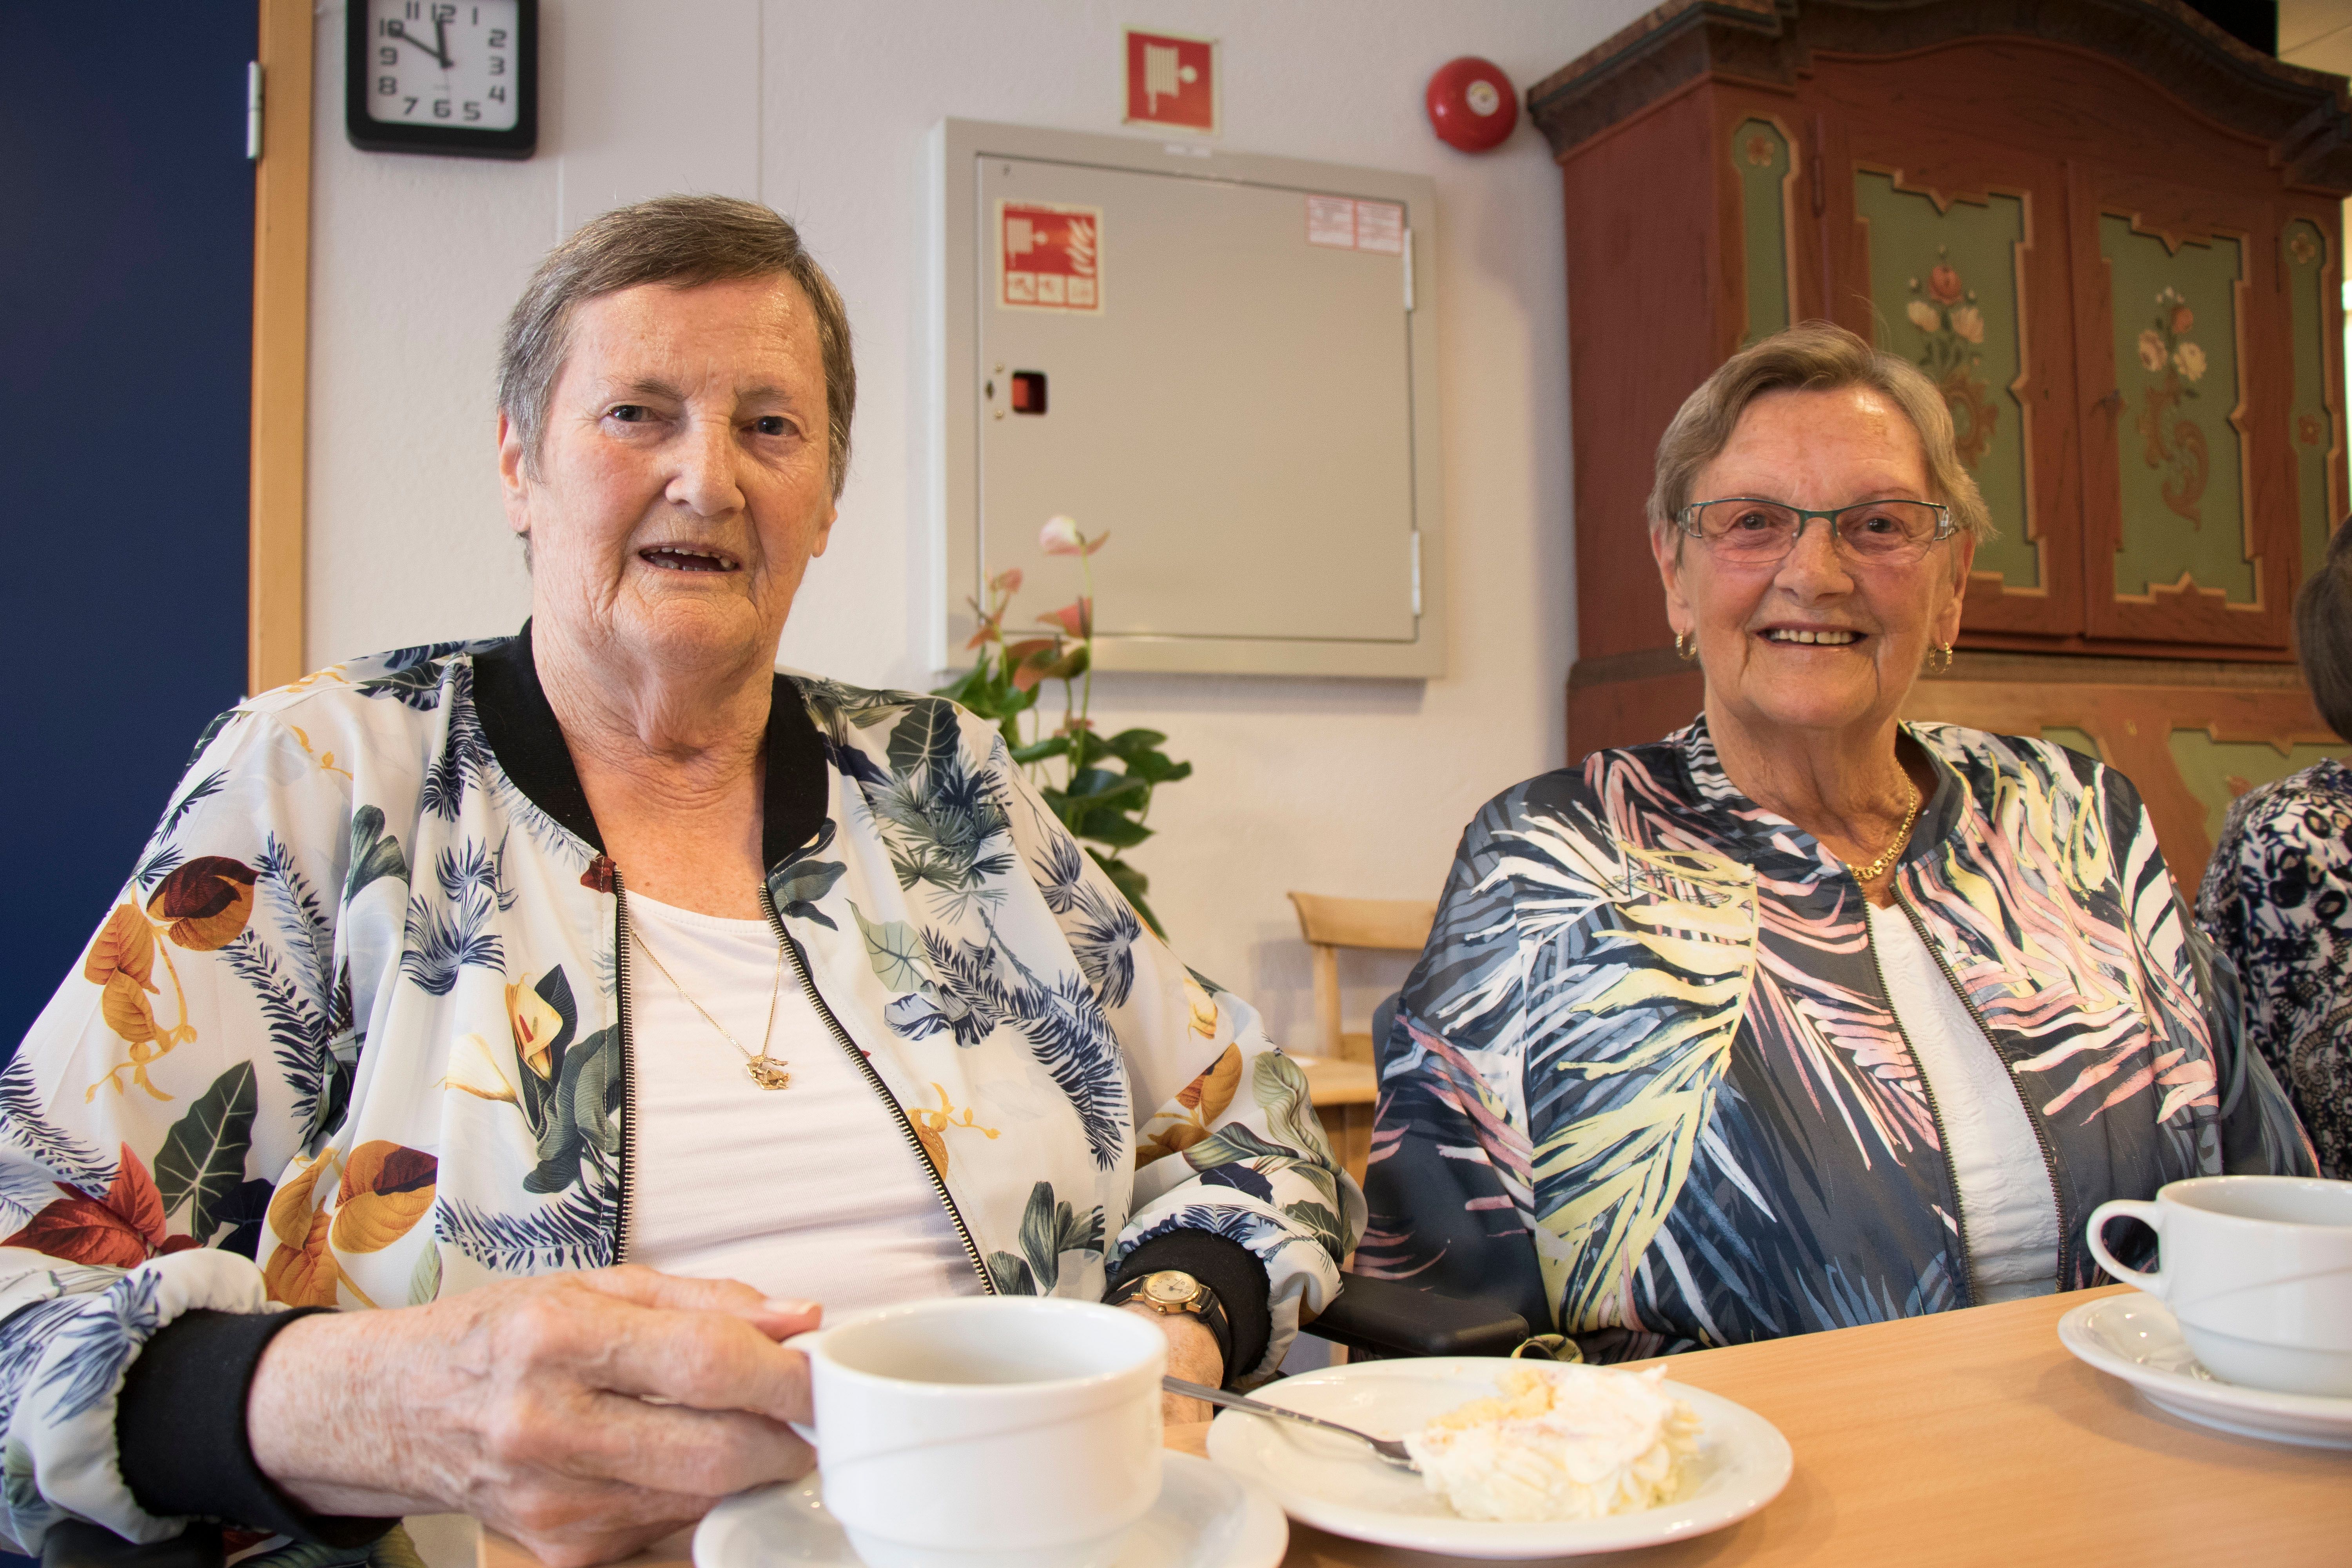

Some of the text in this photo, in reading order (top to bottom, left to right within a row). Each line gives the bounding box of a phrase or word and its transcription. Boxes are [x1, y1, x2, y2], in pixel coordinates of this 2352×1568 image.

[405, 1, 419, 20] 11
[432, 3, 456, 23] 12
[472, 6, 477, 25] 1
[379, 19, 404, 38] 10
[488, 29, 506, 47] 2
[380, 46, 397, 65] 9
[490, 56, 505, 75] 3
[378, 76, 396, 95] 8
[489, 86, 505, 104] 4
[404, 96, 419, 115] 7
[433, 98, 451, 118] 6
[463, 101, 481, 121] 5
